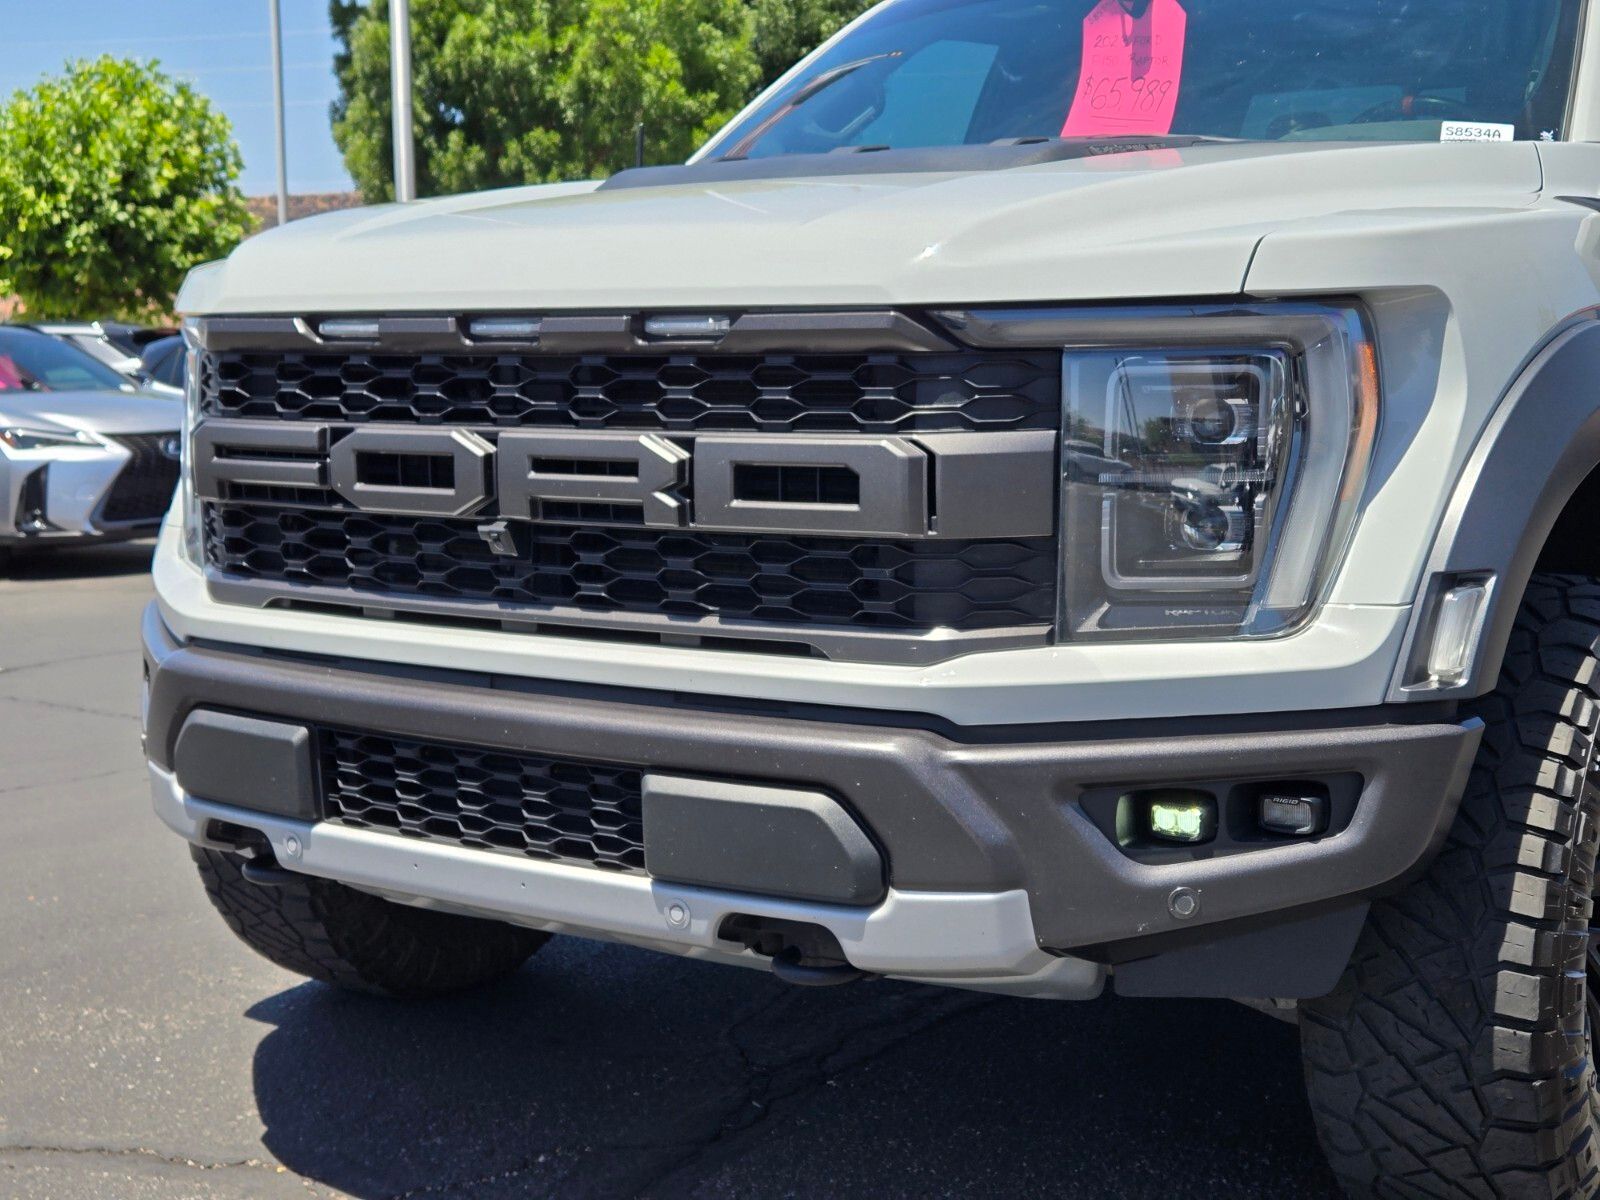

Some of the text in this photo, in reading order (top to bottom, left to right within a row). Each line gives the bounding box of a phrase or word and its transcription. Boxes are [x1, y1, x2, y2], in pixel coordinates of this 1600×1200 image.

[1446, 126, 1501, 138] S8534A
[193, 417, 932, 538] FORD
[1272, 797, 1299, 805] RIGID
